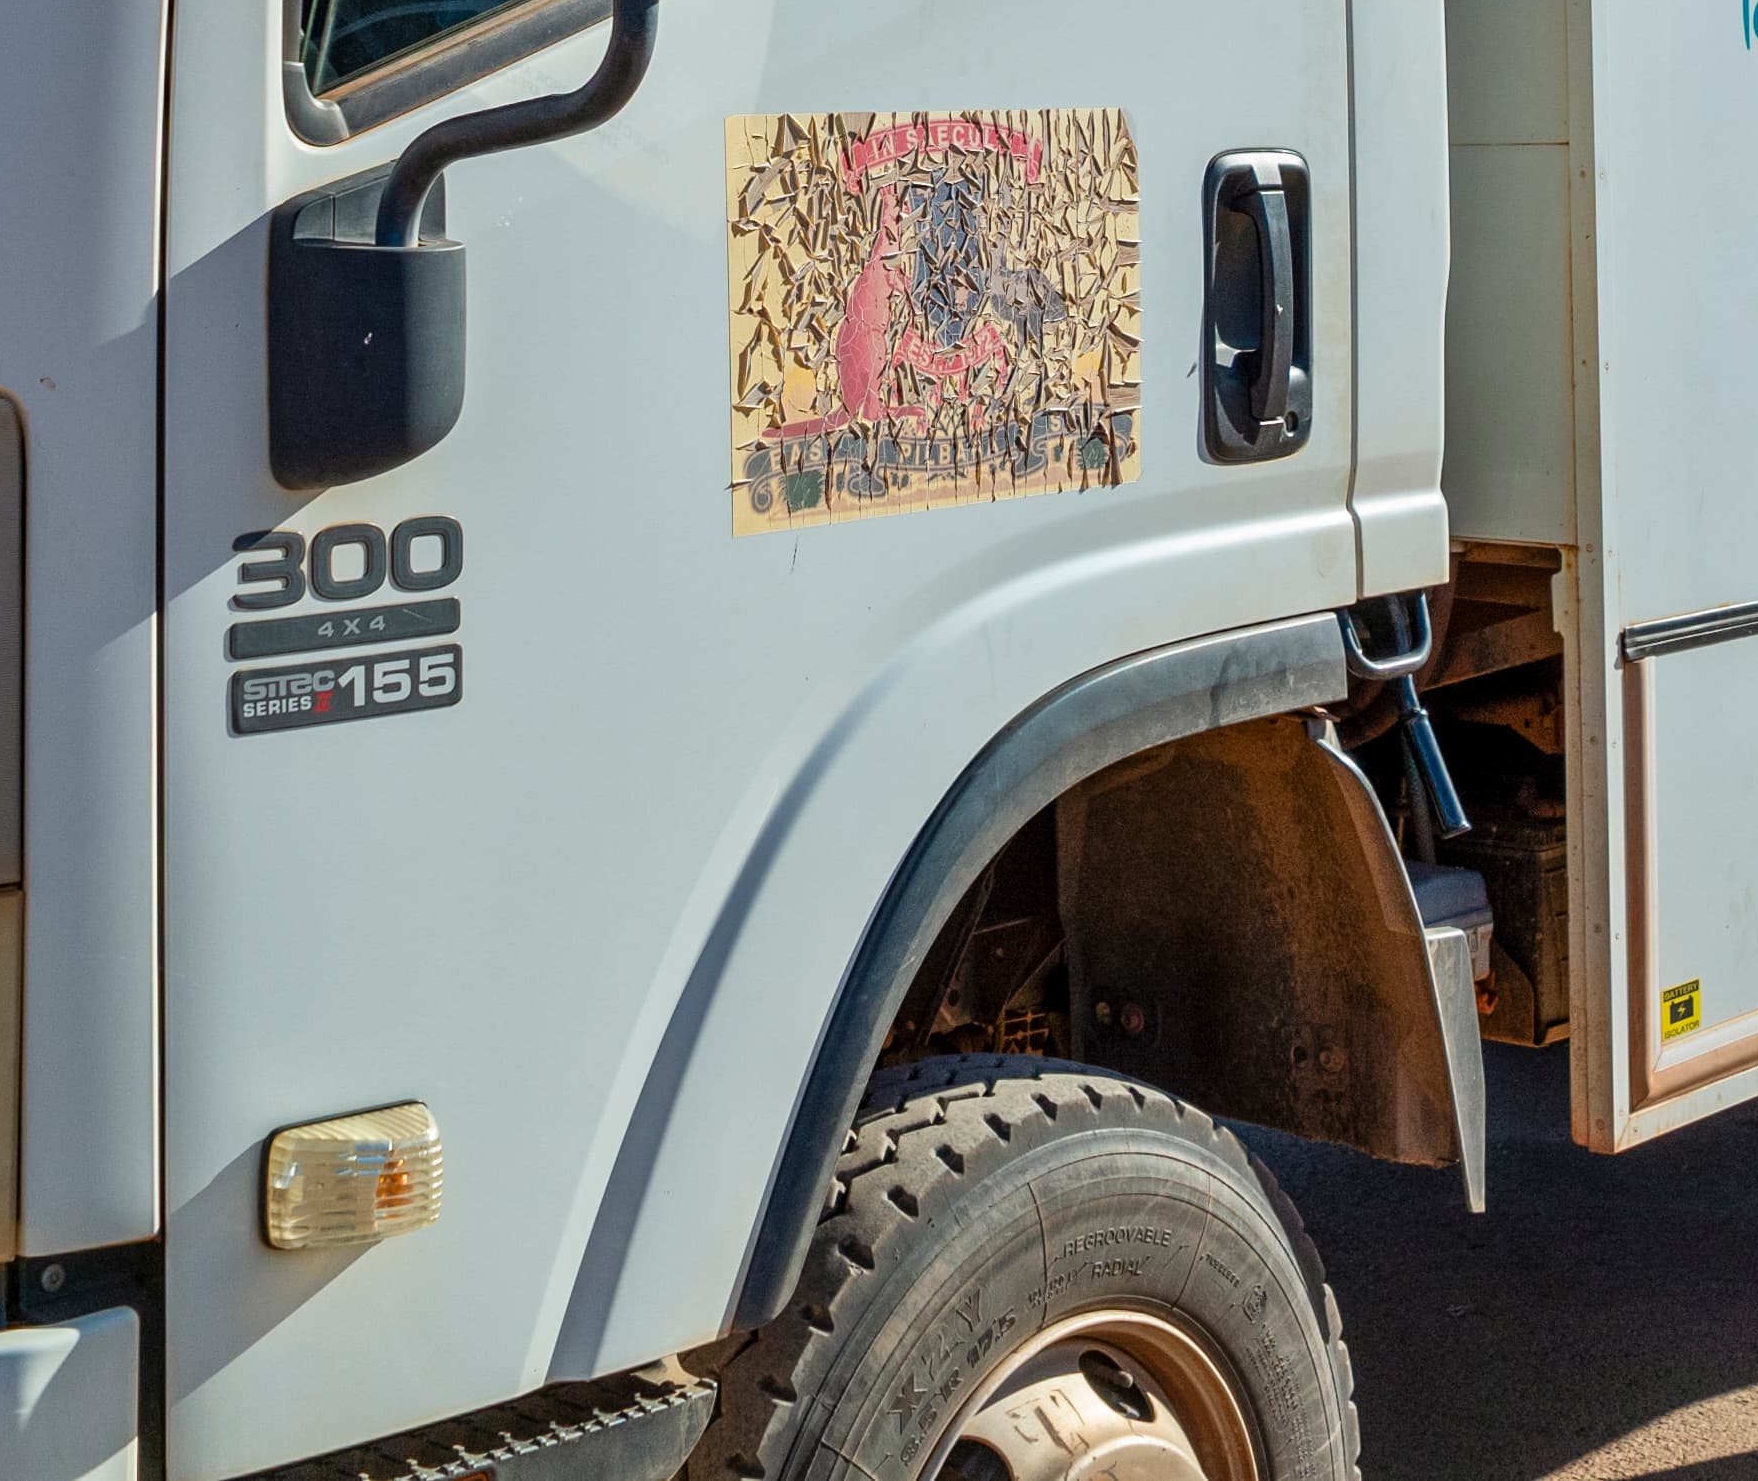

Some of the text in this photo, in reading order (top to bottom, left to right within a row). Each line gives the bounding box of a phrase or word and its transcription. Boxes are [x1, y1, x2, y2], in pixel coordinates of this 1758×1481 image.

[769, 443, 825, 472] EAS
[231, 516, 463, 611] 300
[338, 653, 455, 707] 155
[244, 696, 312, 718] SERIES
[1663, 982, 1698, 1001] BATTERY
[1664, 1020, 1699, 1039] ISOLATOR
[1063, 1227, 1172, 1257] REGROOVABLE
[1092, 1257, 1142, 1281] RADIAL
